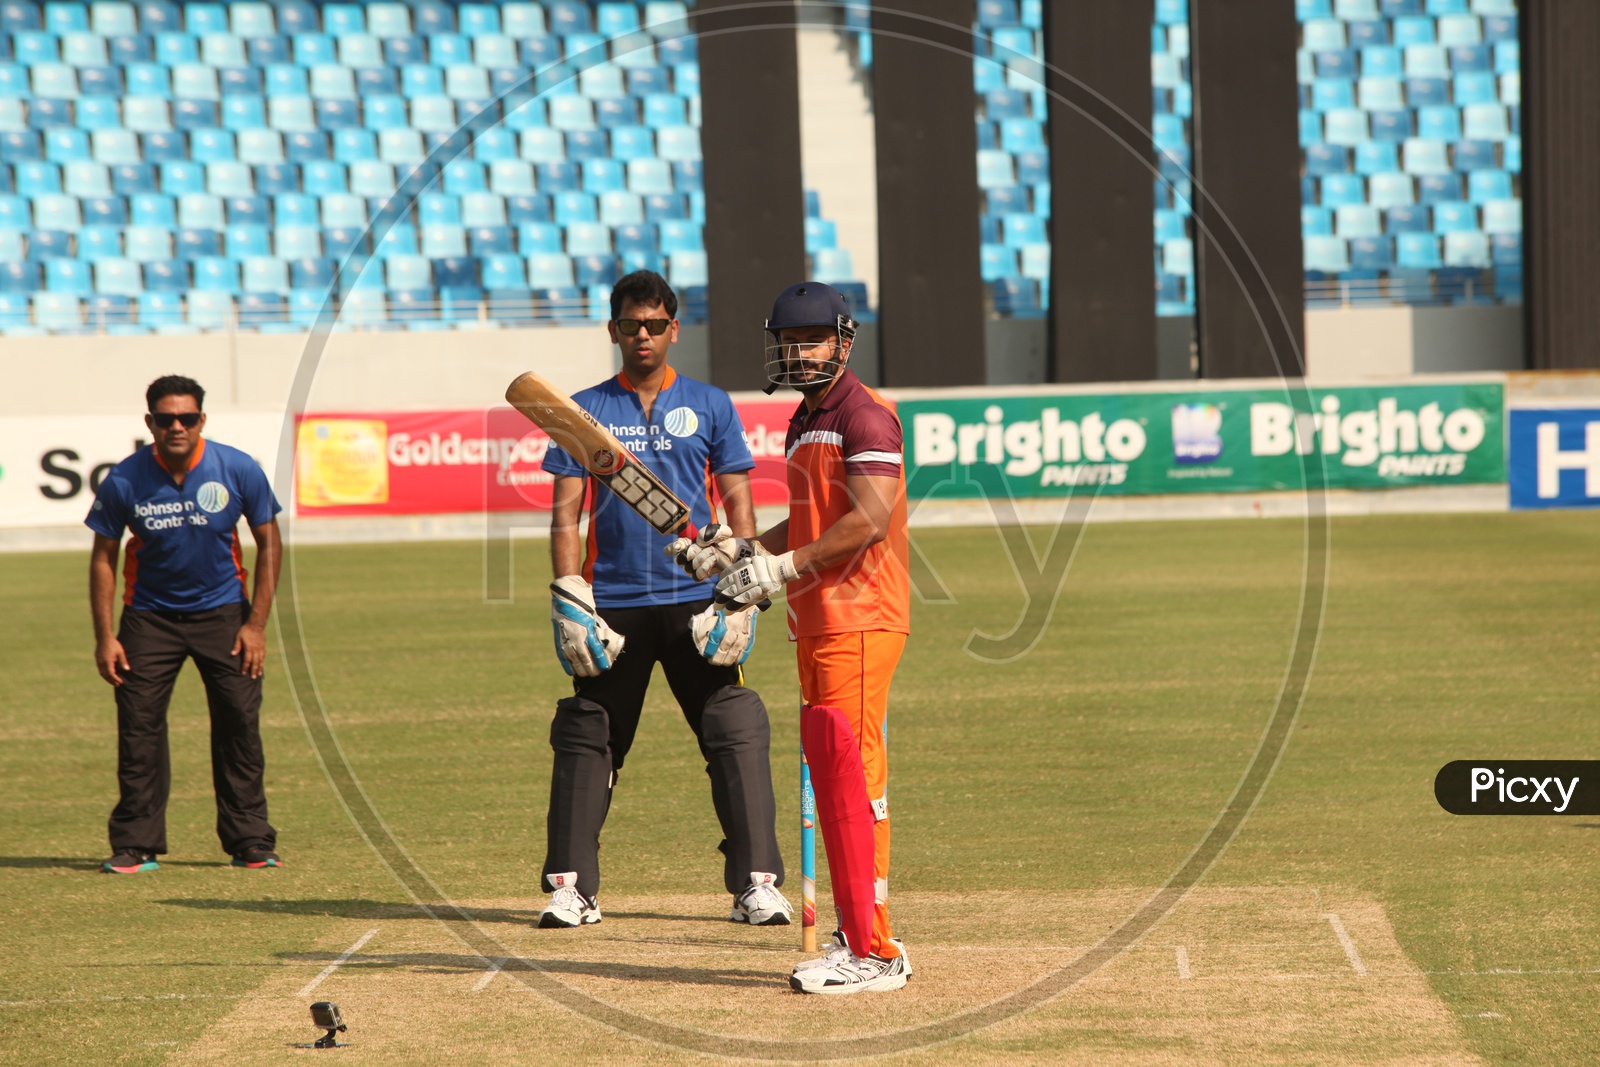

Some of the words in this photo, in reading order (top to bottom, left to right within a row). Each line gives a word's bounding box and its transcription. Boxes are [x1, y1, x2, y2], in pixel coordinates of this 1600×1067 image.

[605, 423, 659, 436] hnson
[747, 424, 786, 457] de
[913, 405, 1147, 477] Brighto
[1250, 395, 1486, 467] Brighto
[619, 436, 672, 452] ntrols
[1040, 463, 1128, 487] PAINTS
[1377, 453, 1468, 477] PAINTS
[610, 466, 679, 528] SS
[134, 501, 195, 518] Johnson
[144, 512, 208, 530] Controls
